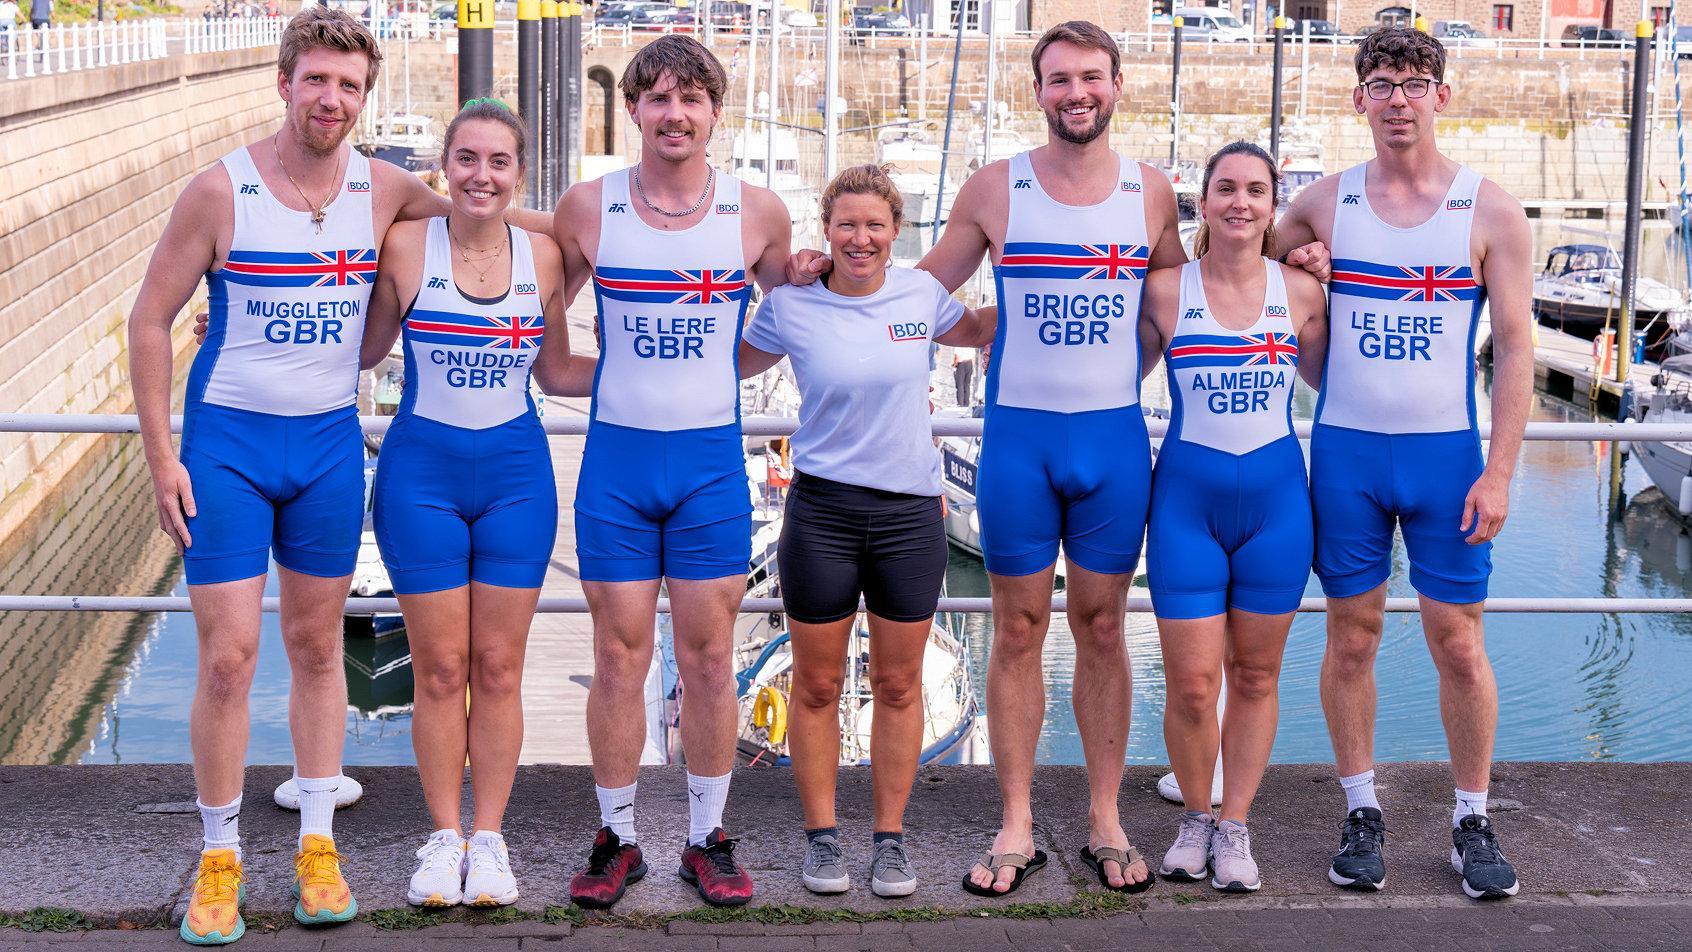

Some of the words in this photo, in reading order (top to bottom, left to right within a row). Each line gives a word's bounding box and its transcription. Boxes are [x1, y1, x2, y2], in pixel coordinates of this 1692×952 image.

[467, 3, 482, 22] H
[349, 182, 370, 190] BDO
[1123, 182, 1141, 191] BDO
[718, 204, 739, 213] BDO
[1449, 199, 1472, 208] BDO
[517, 284, 536, 293] BDO
[246, 299, 361, 319] MUGGLETON
[1024, 293, 1125, 319] BRIGGS
[1267, 306, 1286, 315] BDO
[264, 319, 343, 345] GBR
[623, 315, 649, 334] LE
[657, 317, 716, 335] LERE
[892, 322, 928, 338] BDO
[1351, 311, 1376, 331] LE
[1383, 314, 1443, 334] LERE
[1038, 320, 1110, 346] GBR
[633, 335, 704, 360] GBR
[1359, 332, 1432, 361] GBR
[430, 349, 528, 369] CNUDDE
[446, 367, 508, 389] GBR
[1192, 371, 1285, 391] ALMEIDA
[1208, 391, 1270, 414] GBR
[950, 460, 973, 486] BLISS
